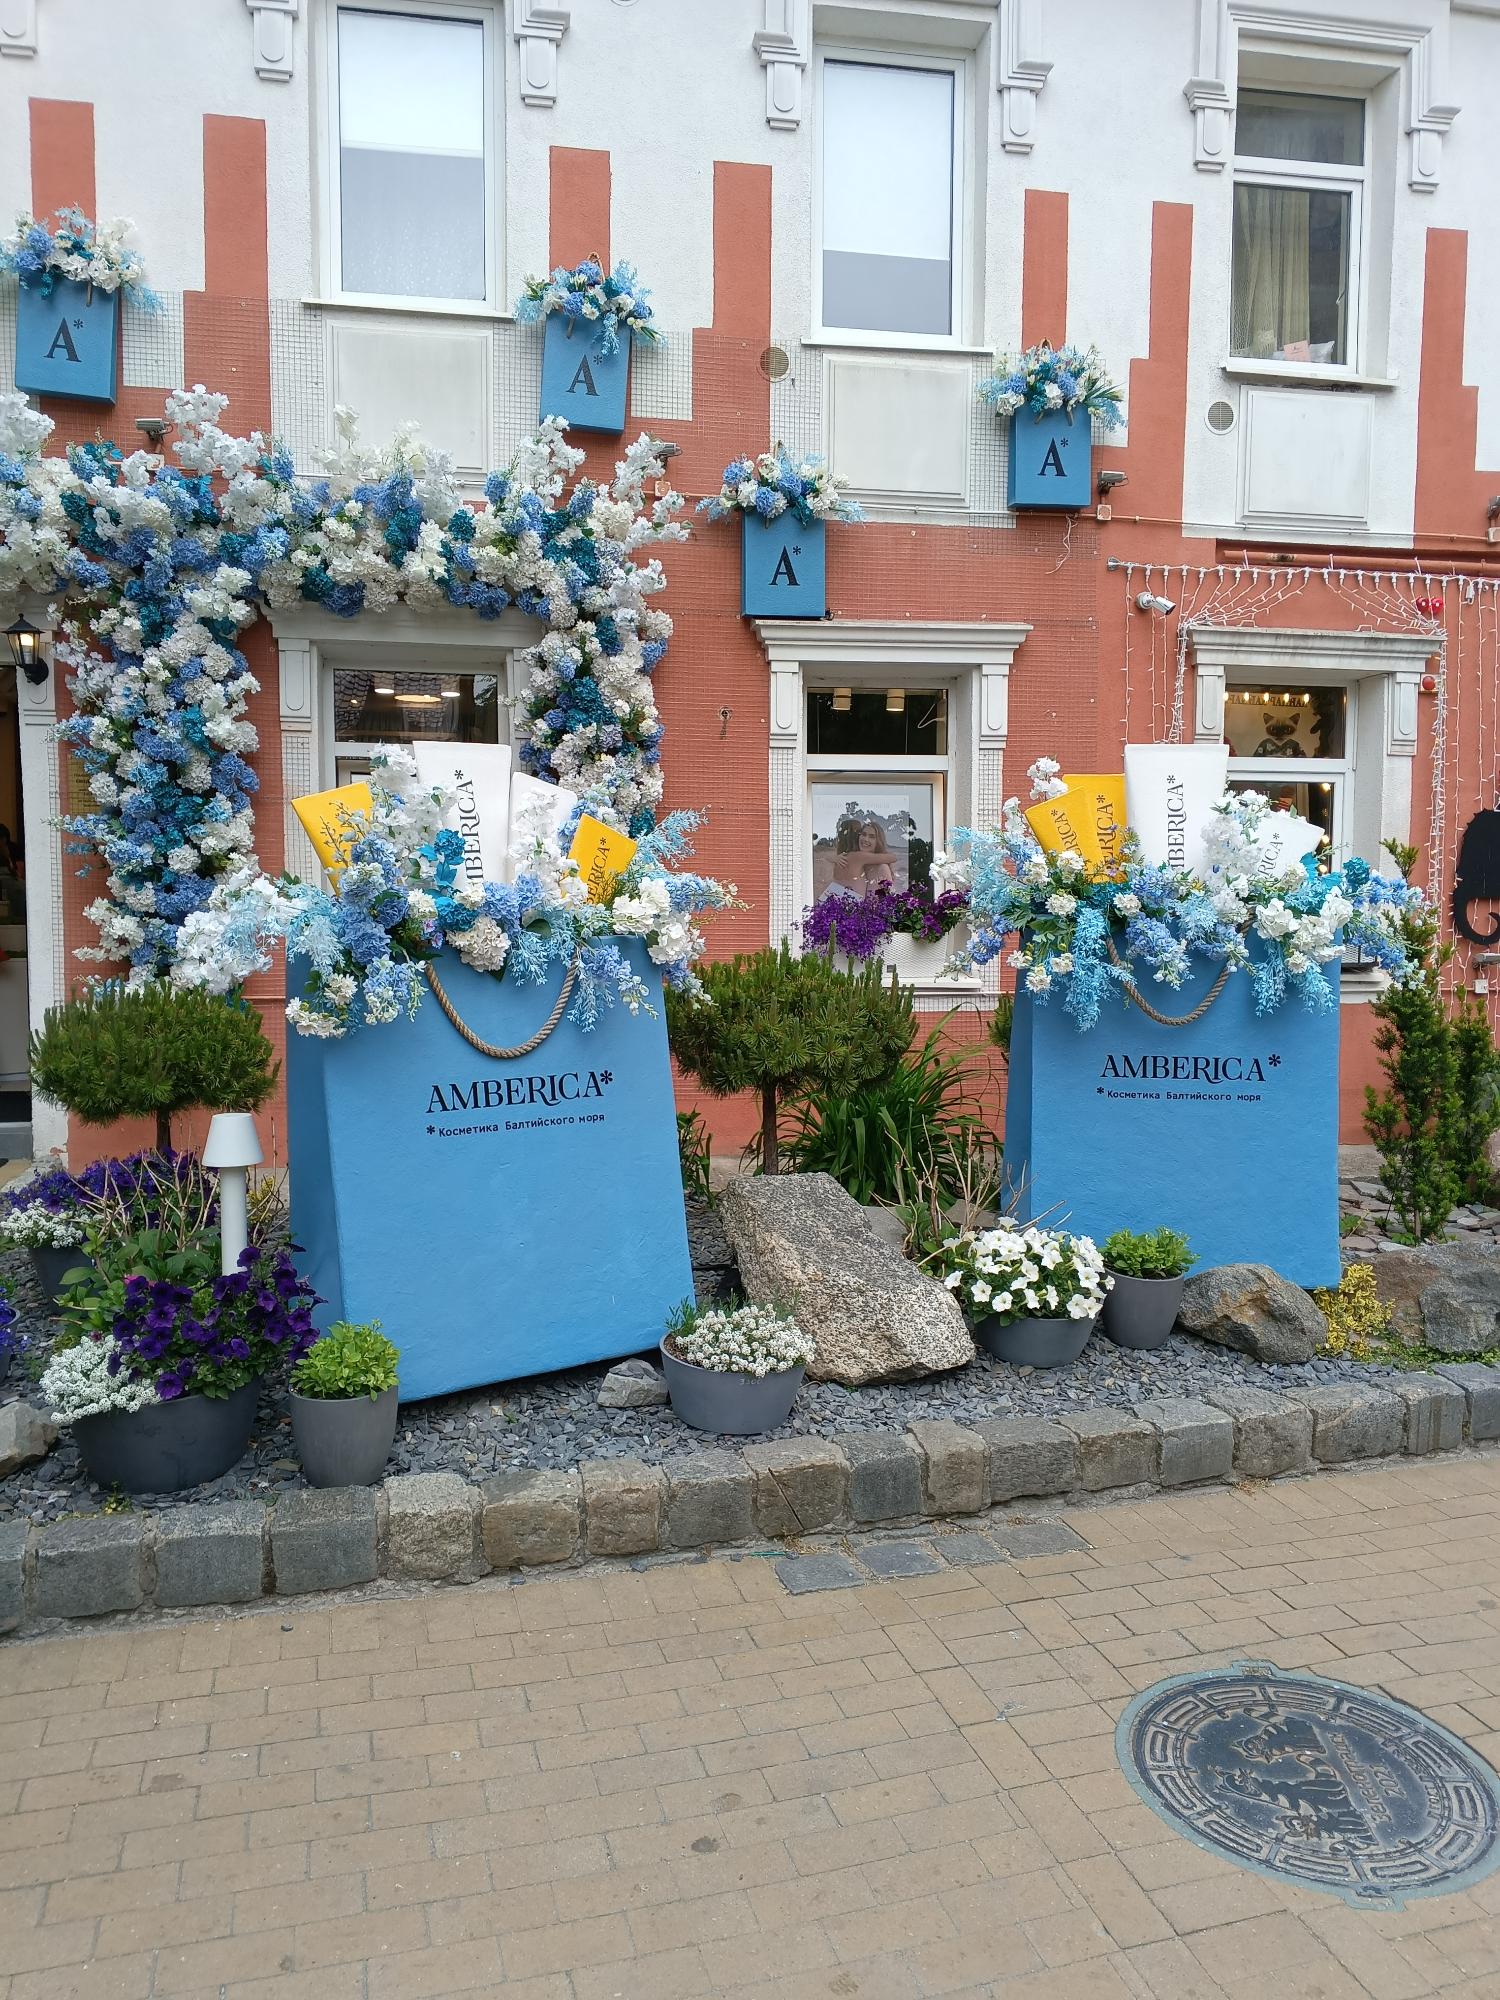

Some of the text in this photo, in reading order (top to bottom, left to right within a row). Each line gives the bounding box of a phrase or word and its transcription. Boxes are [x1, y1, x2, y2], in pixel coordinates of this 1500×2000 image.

[454, 769, 484, 880] BERICA
[1166, 774, 1187, 868] BERICA
[505, 1115, 575, 1131] Балтийского
[579, 1112, 605, 1124] моря
[1166, 1091, 1232, 1101] Балтийского
[1237, 1093, 1261, 1103] моря
